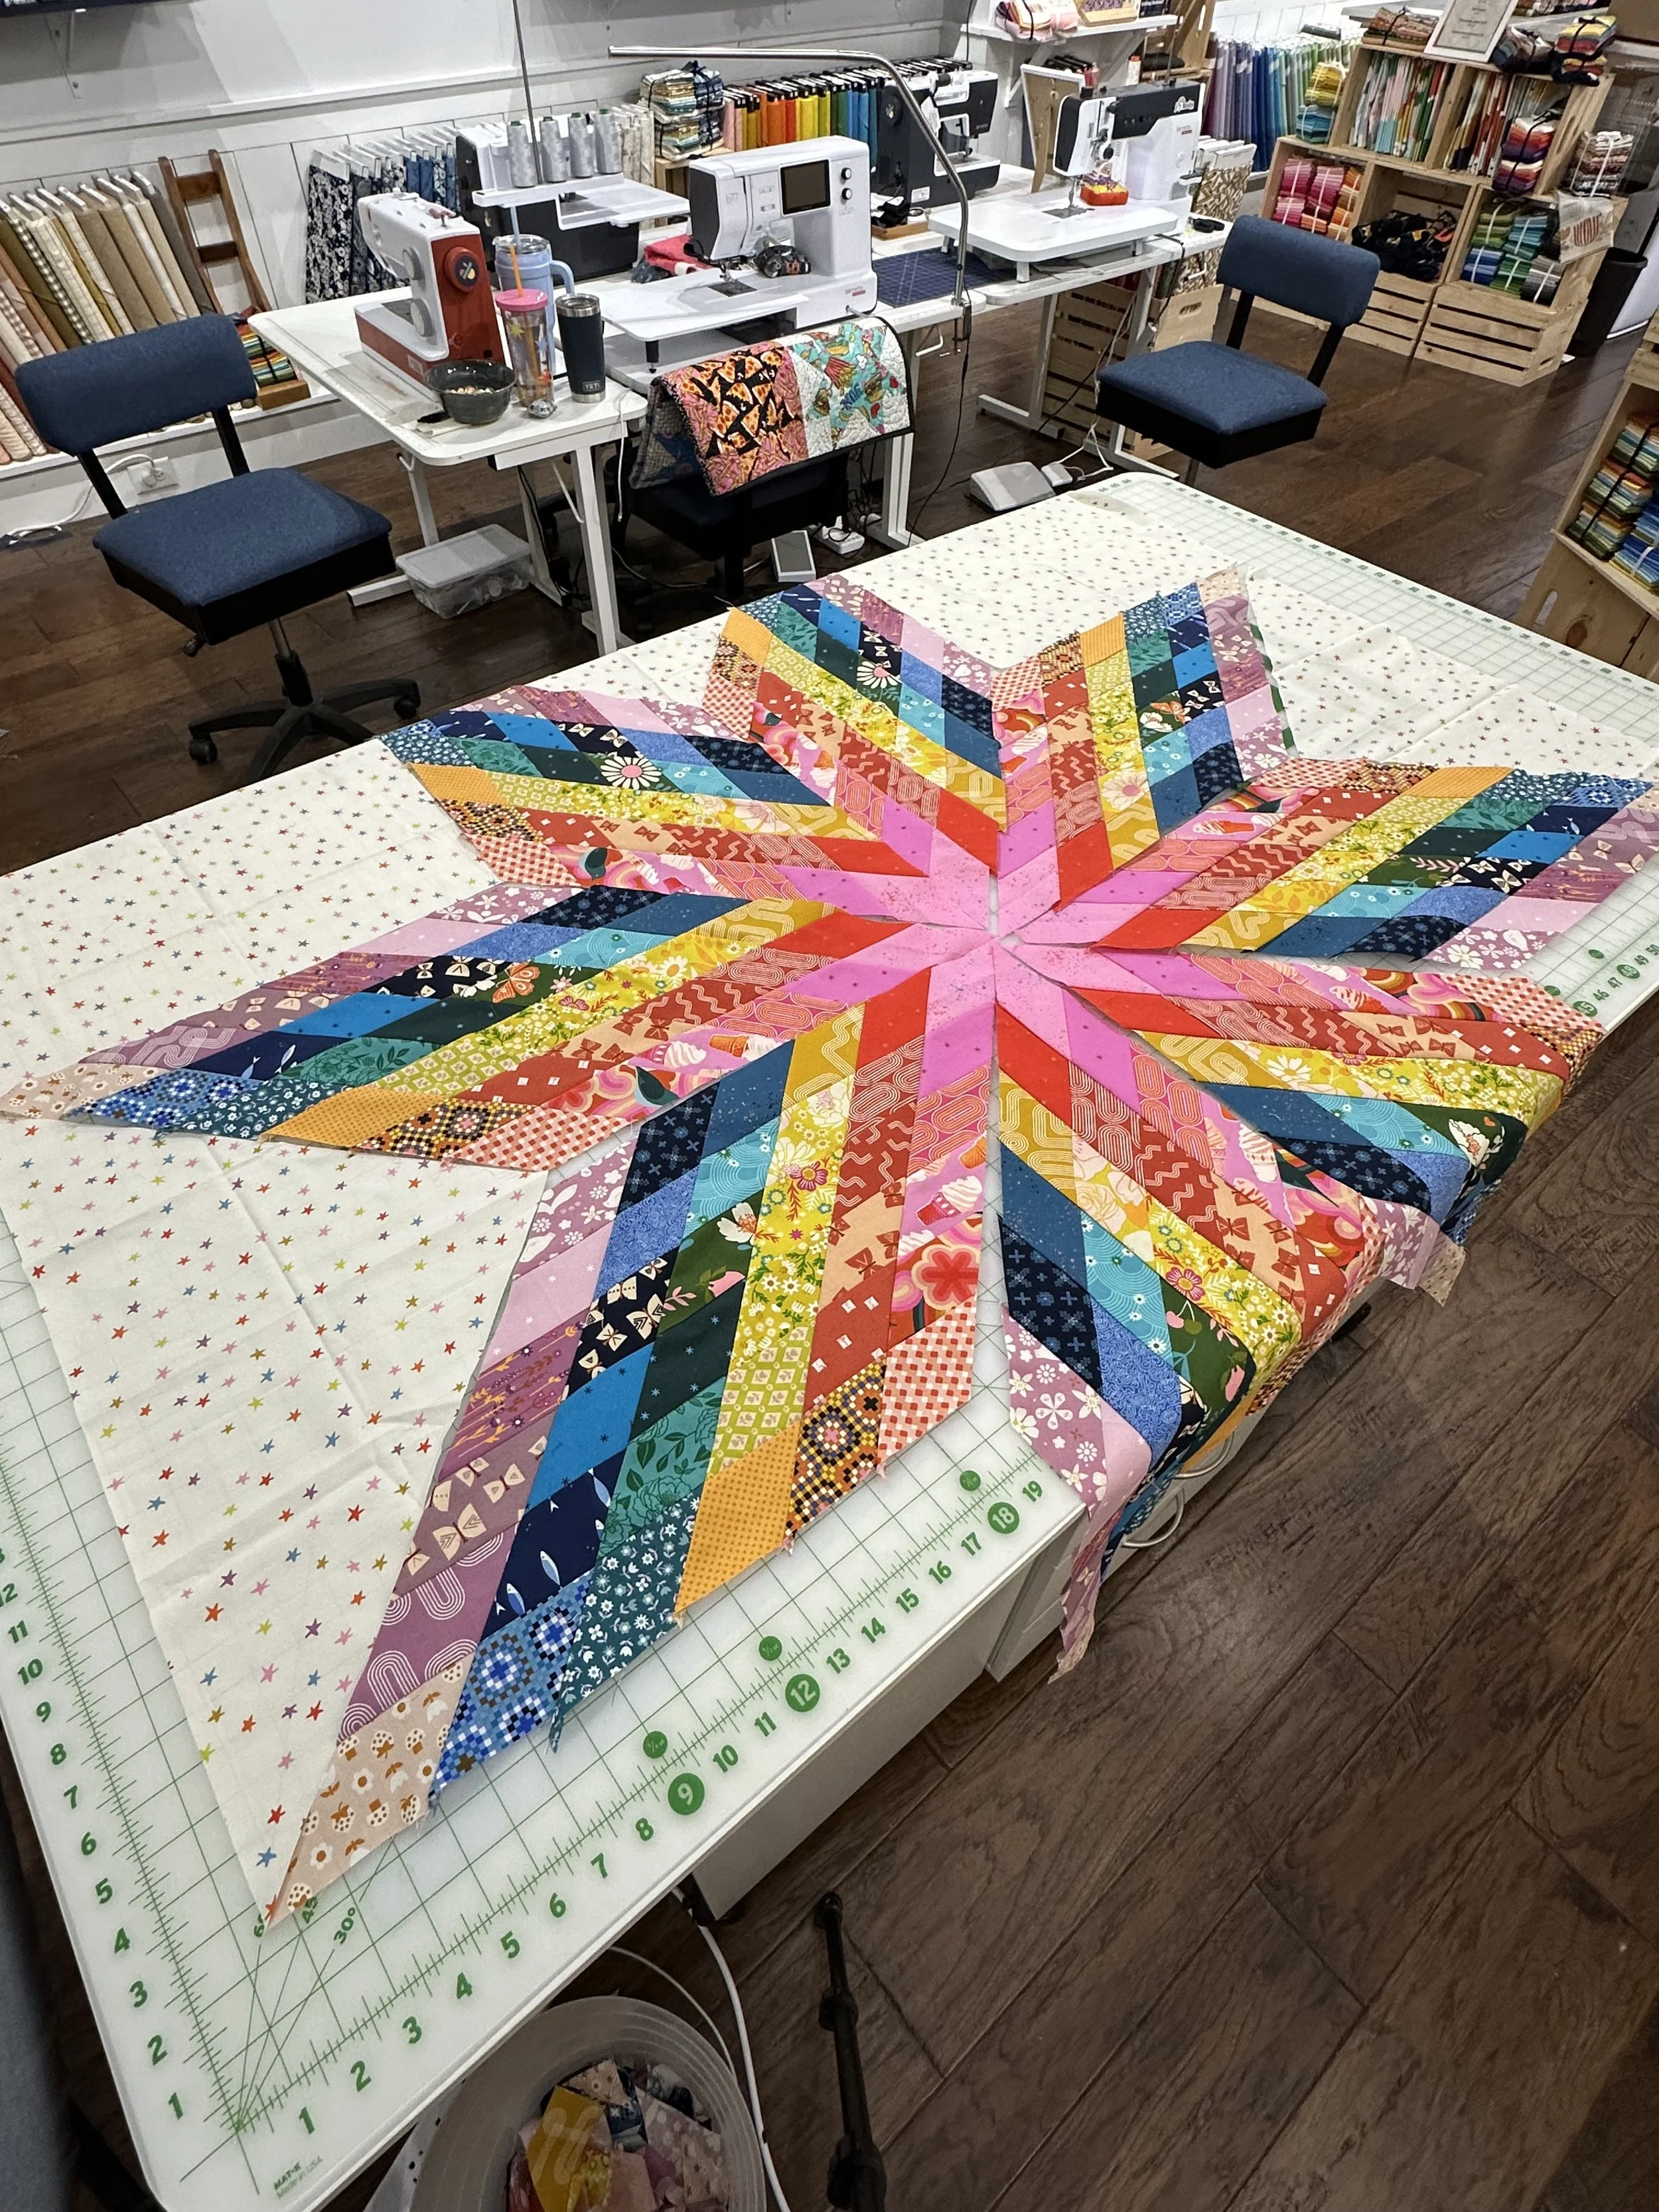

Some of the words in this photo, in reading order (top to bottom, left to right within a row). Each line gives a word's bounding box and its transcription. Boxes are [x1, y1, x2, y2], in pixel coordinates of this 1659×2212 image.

[585, 382, 600, 393] YETI
[299, 2108, 315, 2134] 1
[350, 2060, 372, 2092] 2
[403, 2016, 423, 2045] 3
[456, 1972, 473, 2000] 4
[500, 1932, 521, 1959] 5
[549, 1893, 567, 1919] 6
[592, 1852, 609, 1878] 7
[635, 1817, 654, 1842] 8
[678, 1783, 694, 1806] 9
[713, 1744, 739, 1773] 10
[755, 1712, 777, 1737] 11
[790, 1679, 817, 1706] 12
[826, 1648, 851, 1673] 13
[861, 1617, 887, 1643] 14
[895, 1587, 920, 1613] 15
[928, 1560, 952, 1584] 16
[960, 1531, 982, 1556] 17
[991, 1507, 1015, 1529] 18
[1022, 1480, 1043, 1502] 19
[1593, 989, 1609, 1001] 46
[1607, 976, 1623, 988] 47
[1621, 965, 1637, 978] 48
[1634, 954, 1649, 966] 49
[8, 1619, 29, 1643] 11
[18, 1658, 44, 1684] 10
[36, 1700, 52, 1722] 9
[50, 1743, 68, 1766] 8
[64, 1785, 79, 1810] 7
[80, 1832, 98, 1856] 6
[95, 1879, 113, 1904] 5
[113, 1927, 131, 1953] 4
[129, 1980, 148, 2008] 3
[147, 2034, 167, 2065] 2
[169, 2092, 184, 2120] 1
